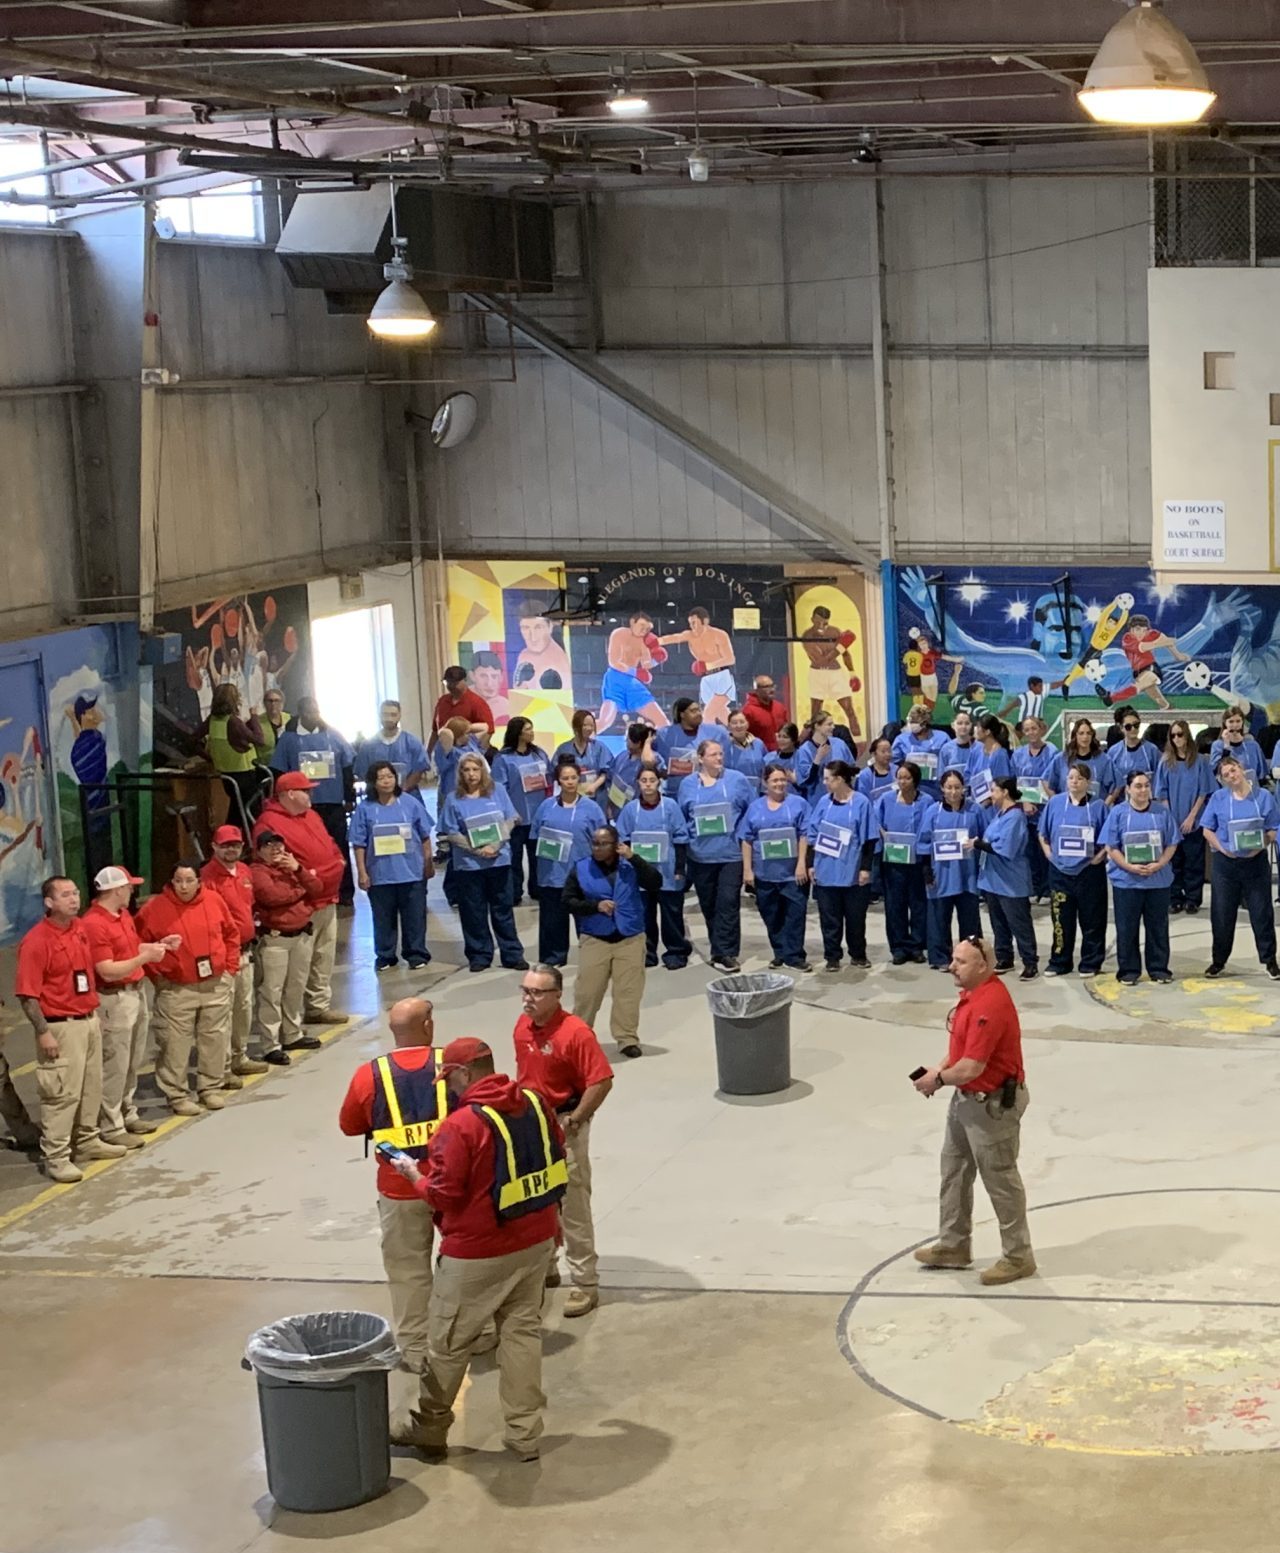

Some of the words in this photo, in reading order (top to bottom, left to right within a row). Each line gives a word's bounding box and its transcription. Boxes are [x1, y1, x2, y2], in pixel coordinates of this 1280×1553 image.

[1166, 505, 1181, 513] NO
[1185, 505, 1223, 513] BOOTS
[1188, 518, 1200, 526] ON
[1167, 530, 1221, 539] BASKETBALL
[1164, 548, 1189, 557] COURT
[1191, 548, 1224, 557] SURFACE
[598, 567, 656, 600] LEGENDS
[663, 566, 685, 577] OF
[695, 566, 752, 601] BOXING
[909, 657, 917, 668] 8
